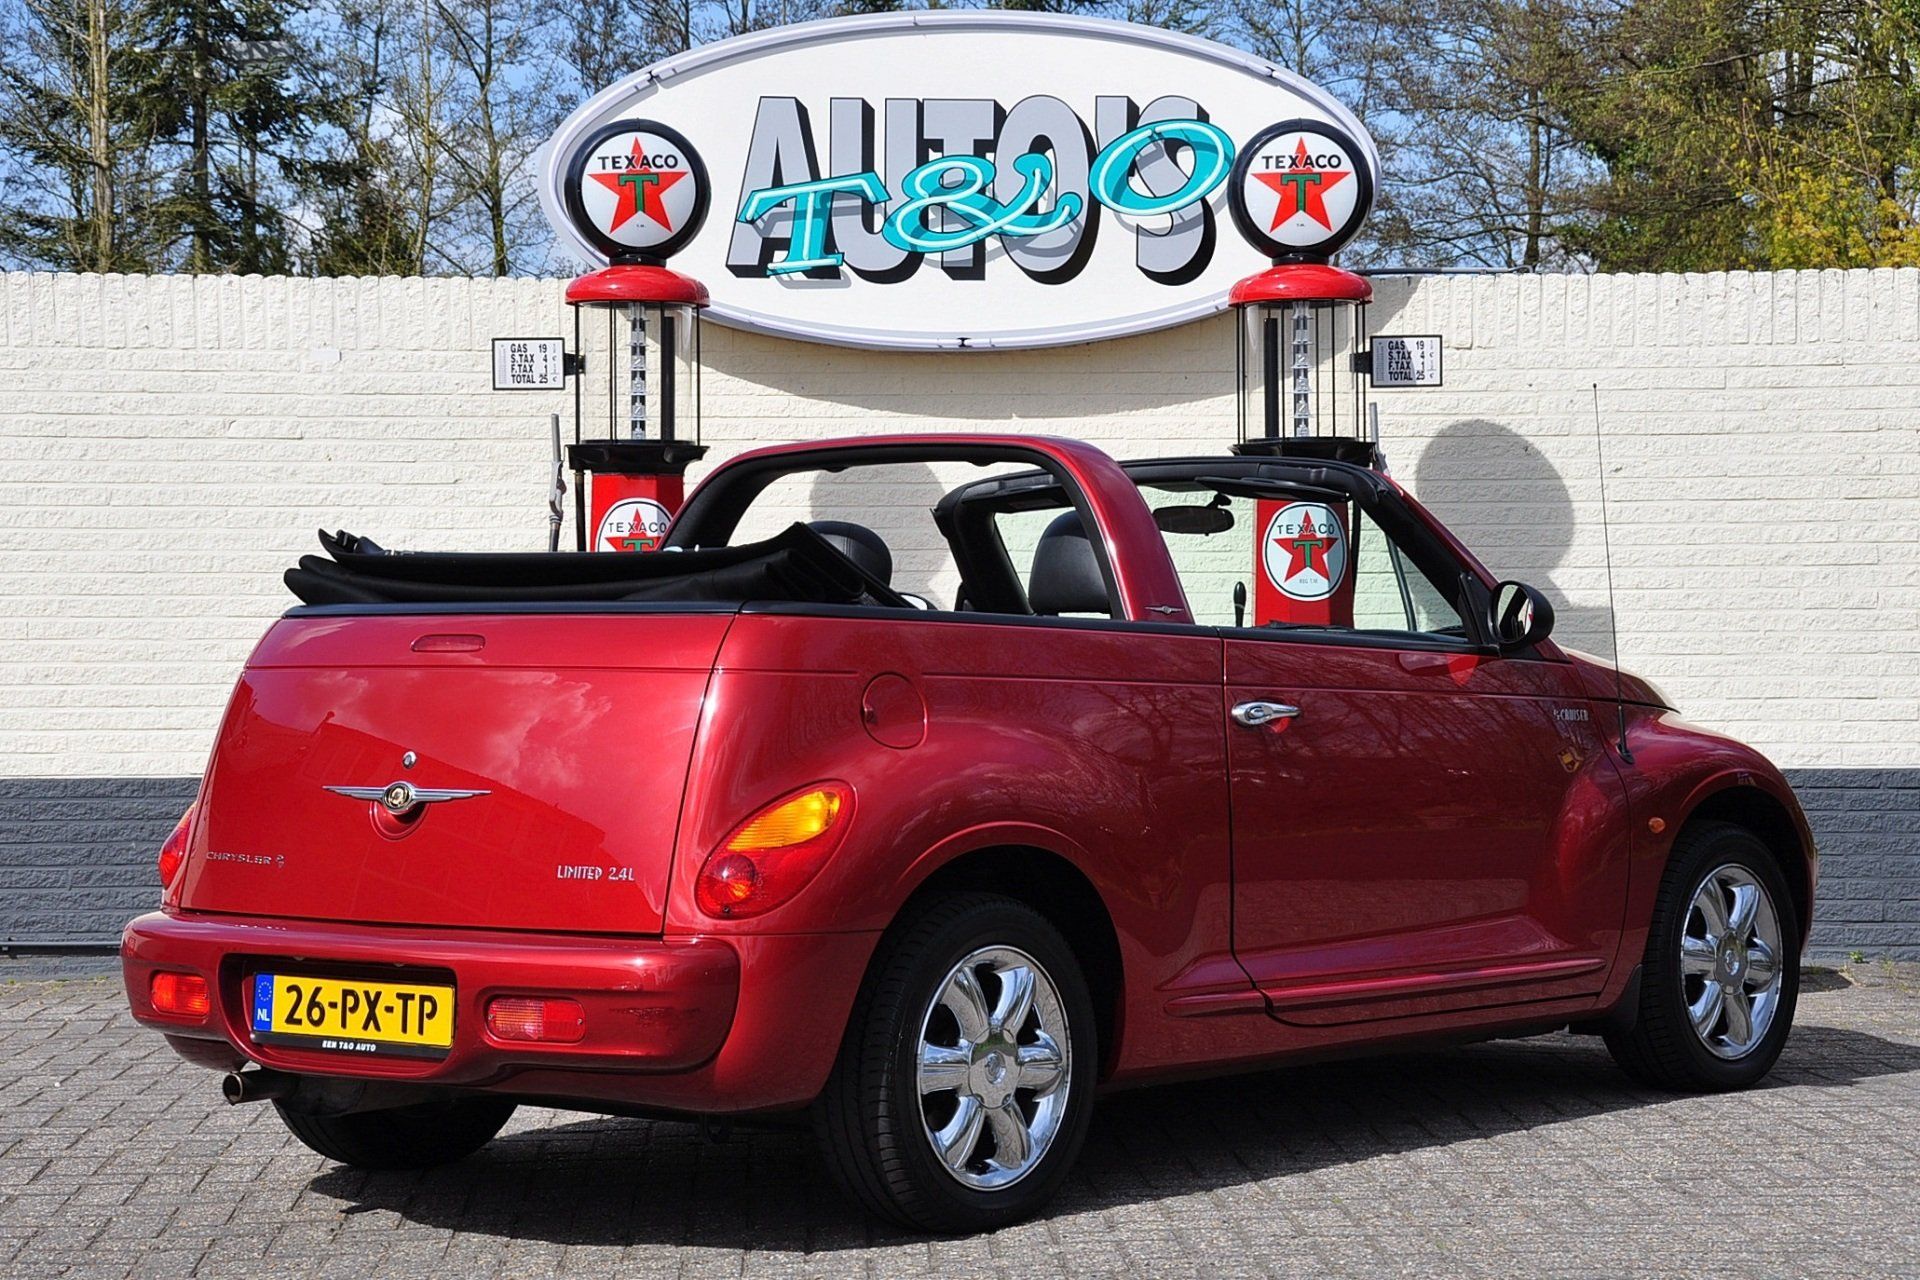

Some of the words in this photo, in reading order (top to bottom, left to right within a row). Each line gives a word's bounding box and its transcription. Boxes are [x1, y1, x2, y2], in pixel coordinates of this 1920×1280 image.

[597, 154, 679, 170] TEXACO
[1261, 154, 1342, 170] TEXACO
[618, 172, 660, 214] T
[726, 94, 1217, 287] AUTO'S
[1280, 172, 1322, 213] T
[510, 343, 528, 354] GAS
[538, 343, 548, 354] 19
[1387, 340, 1406, 351] GAS
[1415, 340, 1425, 351] 19
[510, 353, 535, 364] S.TAX
[1387, 350, 1413, 361] S.TAX
[510, 363, 534, 374] F.TAX
[1388, 360, 1412, 371] F.TAX
[511, 374, 536, 384] TOTAL
[538, 373, 549, 384] 25
[1388, 371, 1413, 381] TOTAL
[1415, 370, 1426, 381] 25
[608, 521, 667, 534] TEXACO
[1277, 523, 1335, 535] TEXACO
[1293, 540, 1324, 568] T
[206, 851, 272, 865] CHRYSLER
[557, 864, 603, 880] LIMITED
[257, 1008, 270, 1022] NL
[284, 983, 438, 1036] 26-PX-TP
[355, 1042, 377, 1052] AUTO
